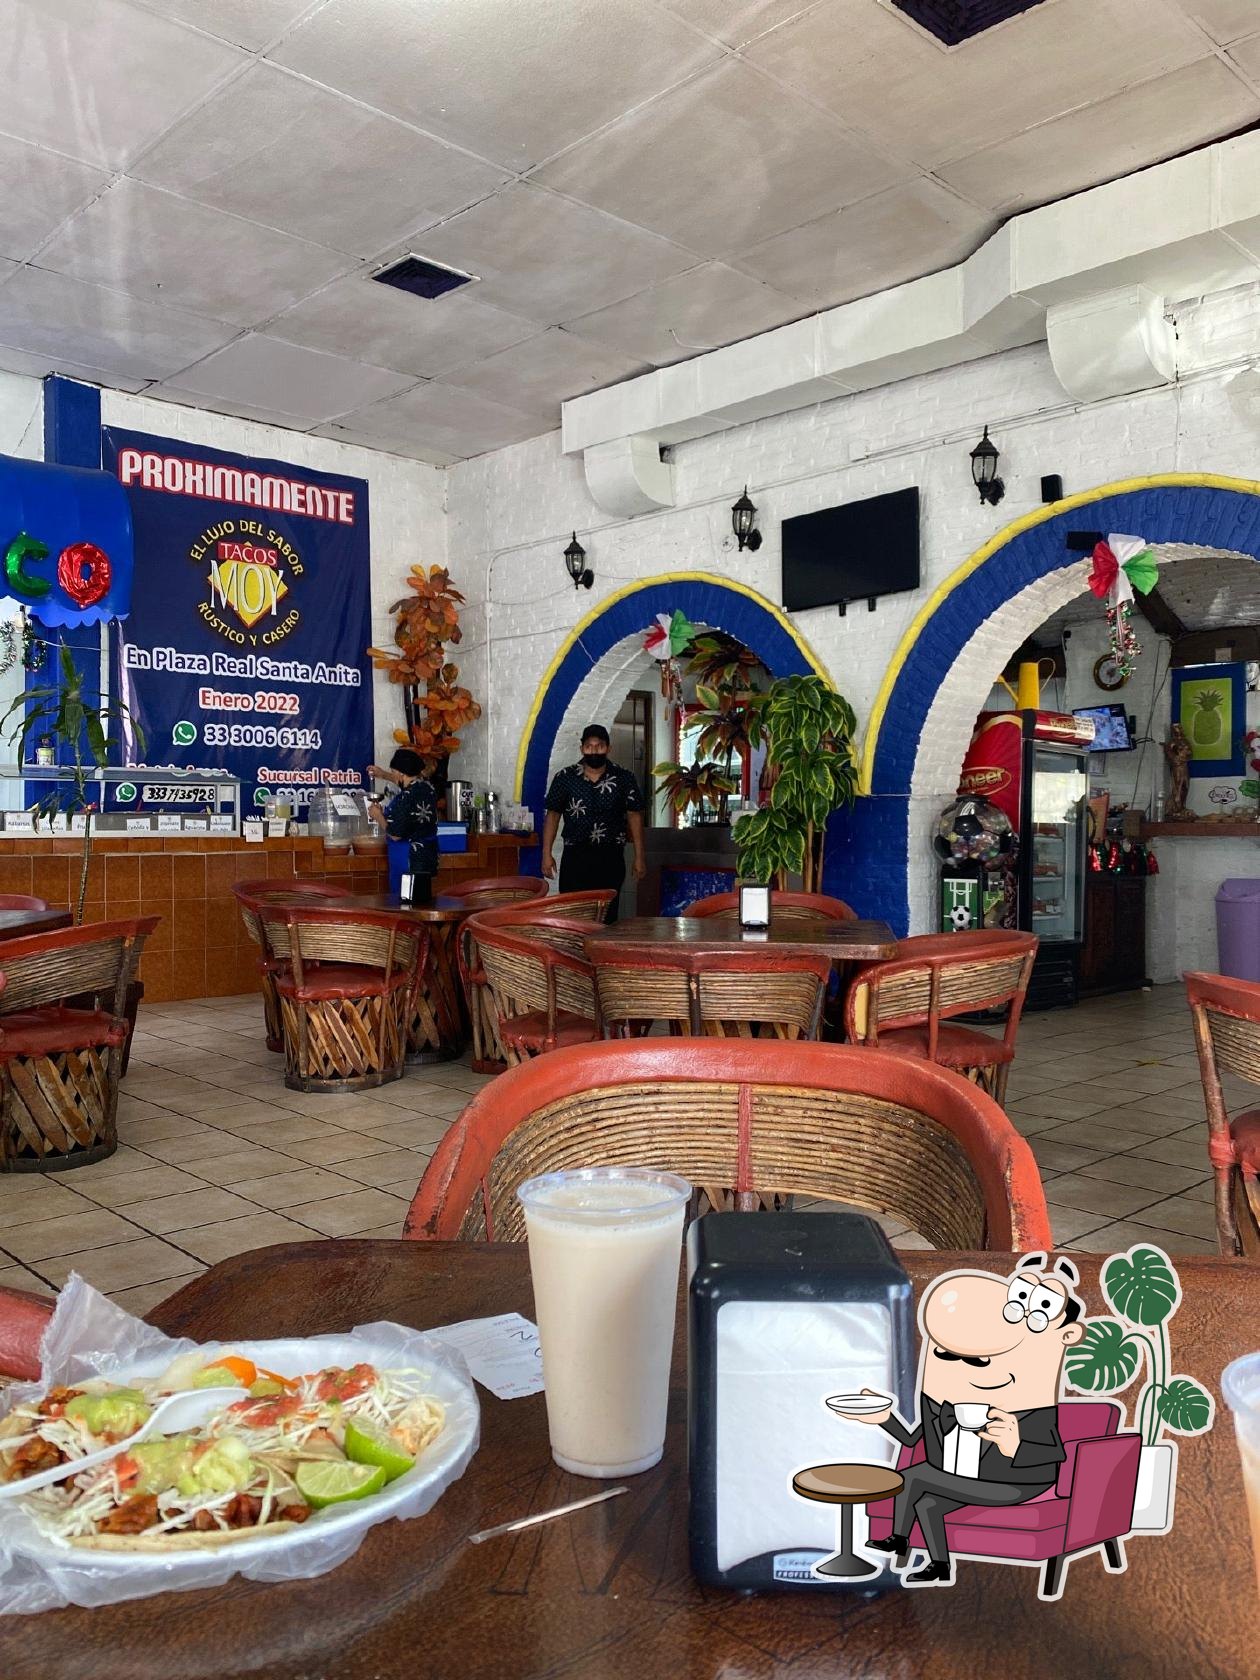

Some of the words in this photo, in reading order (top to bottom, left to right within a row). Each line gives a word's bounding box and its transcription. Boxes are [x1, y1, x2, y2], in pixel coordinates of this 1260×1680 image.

[120, 449, 354, 523] PROXIMAMENTE
[190, 544, 207, 561] EL
[201, 520, 235, 545] LUJO
[239, 519, 264, 536] DEL
[267, 529, 304, 576] SABOR
[220, 542, 277, 566] TACOS
[210, 559, 284, 616] MOY
[197, 601, 245, 645] RUSTICO
[249, 634, 257, 647] Y
[262, 609, 300, 645] CASERO
[126, 646, 149, 668] En
[155, 649, 208, 672] Plaza
[214, 654, 254, 676] Real
[259, 659, 310, 680] Santa
[314, 664, 361, 685] Anita
[200, 689, 251, 710] Enero
[256, 694, 299, 712] 2022
[205, 726, 228, 743] 33
[233, 727, 275, 745] 3006
[280, 730, 320, 748] 6114
[258, 767, 318, 783] Sucursal
[322, 769, 361, 784] Patria
